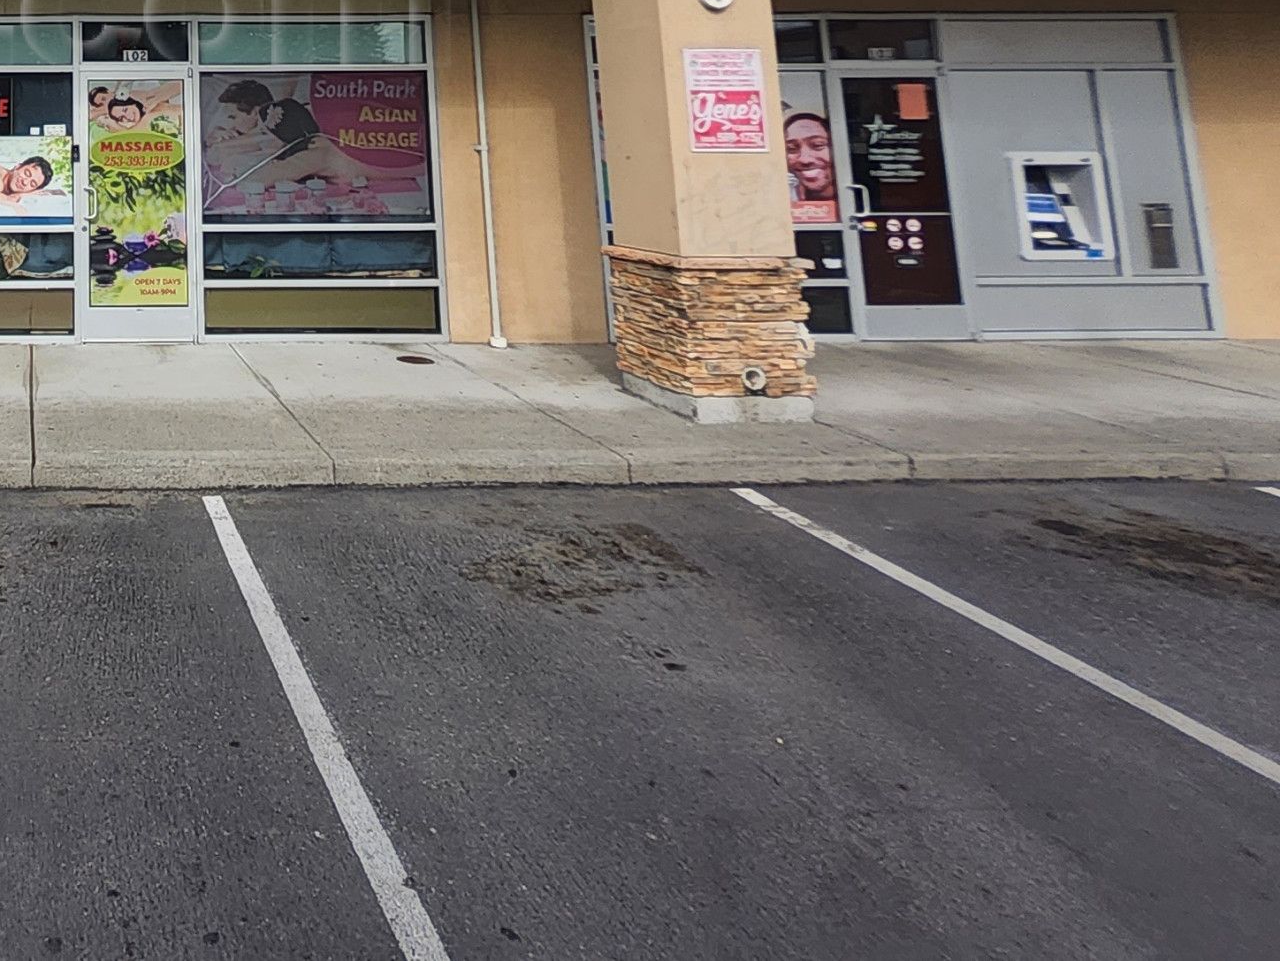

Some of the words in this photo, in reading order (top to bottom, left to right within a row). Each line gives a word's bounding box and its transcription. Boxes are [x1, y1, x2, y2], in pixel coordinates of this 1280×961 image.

[125, 50, 147, 62] 102
[314, 79, 369, 98] South
[372, 79, 416, 98] Park
[100, 141, 173, 152] MASSAGE
[134, 278, 155, 286] OPEN
[156, 278, 161, 286] 7
[162, 278, 182, 286] DAYS
